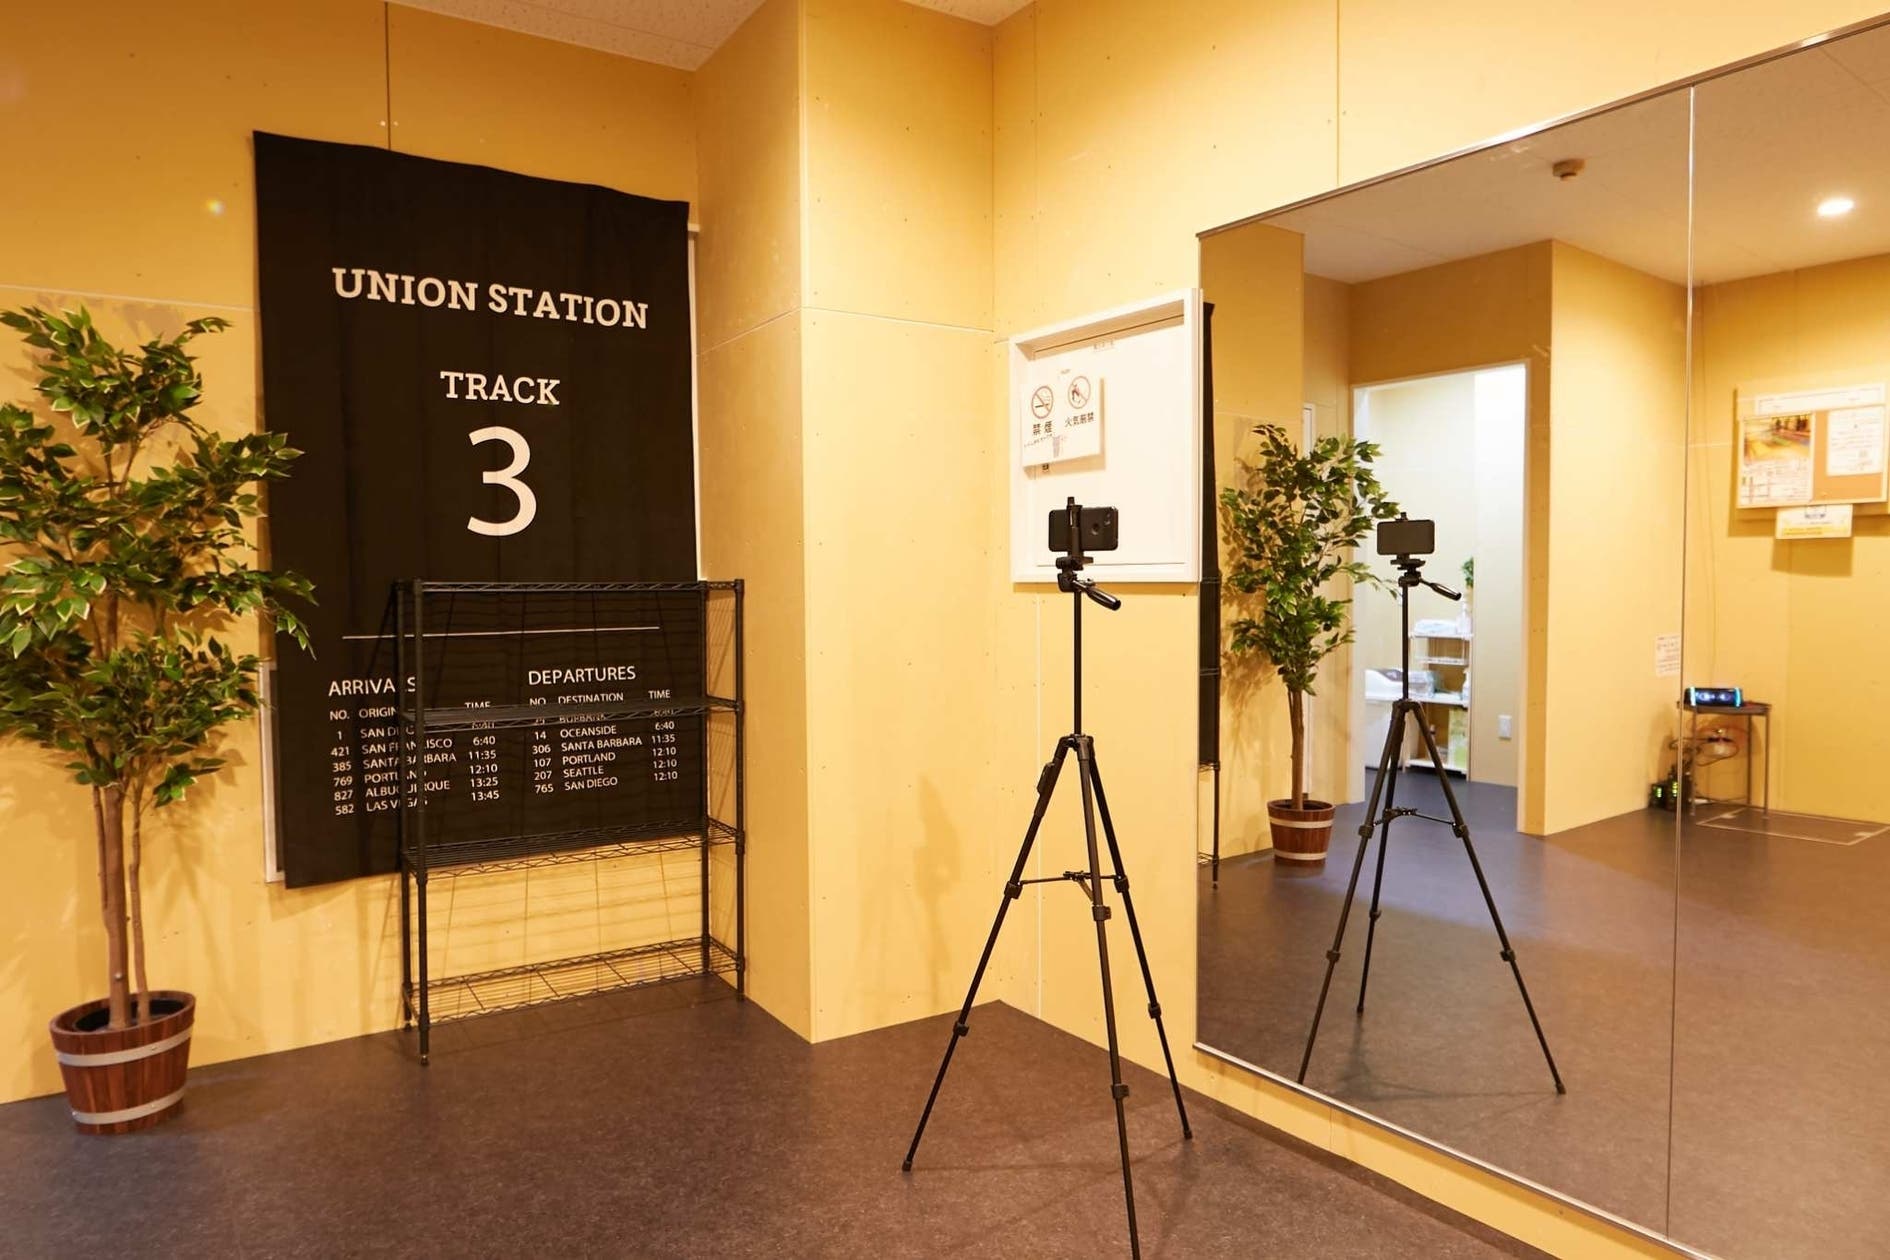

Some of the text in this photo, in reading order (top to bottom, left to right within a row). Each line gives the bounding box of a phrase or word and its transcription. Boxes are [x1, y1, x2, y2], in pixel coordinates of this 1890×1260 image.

[332, 267, 648, 329] UNION STATION
[440, 370, 560, 405] TRACK
[467, 425, 537, 536] 3
[328, 676, 415, 696] ARRIVAS
[528, 666, 636, 685] DEPARTURES
[558, 693, 623, 704] DESTINATION
[648, 690, 670, 700] TIME
[330, 710, 350, 720] NO.
[338, 731, 342, 739] 1
[361, 726, 385, 739] SAN
[535, 721, 674, 740] 14 OCEANSIDE 6:40
[331, 746, 350, 757] 421
[362, 744, 386, 755] SAN
[473, 735, 496, 746] 6:40
[532, 734, 676, 754] 306 SANTA BARBARA 11:35
[332, 761, 351, 772] 385
[468, 750, 497, 760] 11:35
[533, 747, 677, 768] 107 PORTLAND 12:10
[333, 776, 353, 787] 769
[470, 764, 498, 774] 12:10
[534, 759, 677, 781] 207 SEATTLE 12:10
[334, 790, 353, 801] 827
[470, 777, 498, 788] 13:25
[535, 771, 678, 794] 765 SAN DIEGO 12:10
[335, 804, 355, 816] 582
[366, 800, 388, 811] LAS
[472, 790, 500, 801] 13:45
